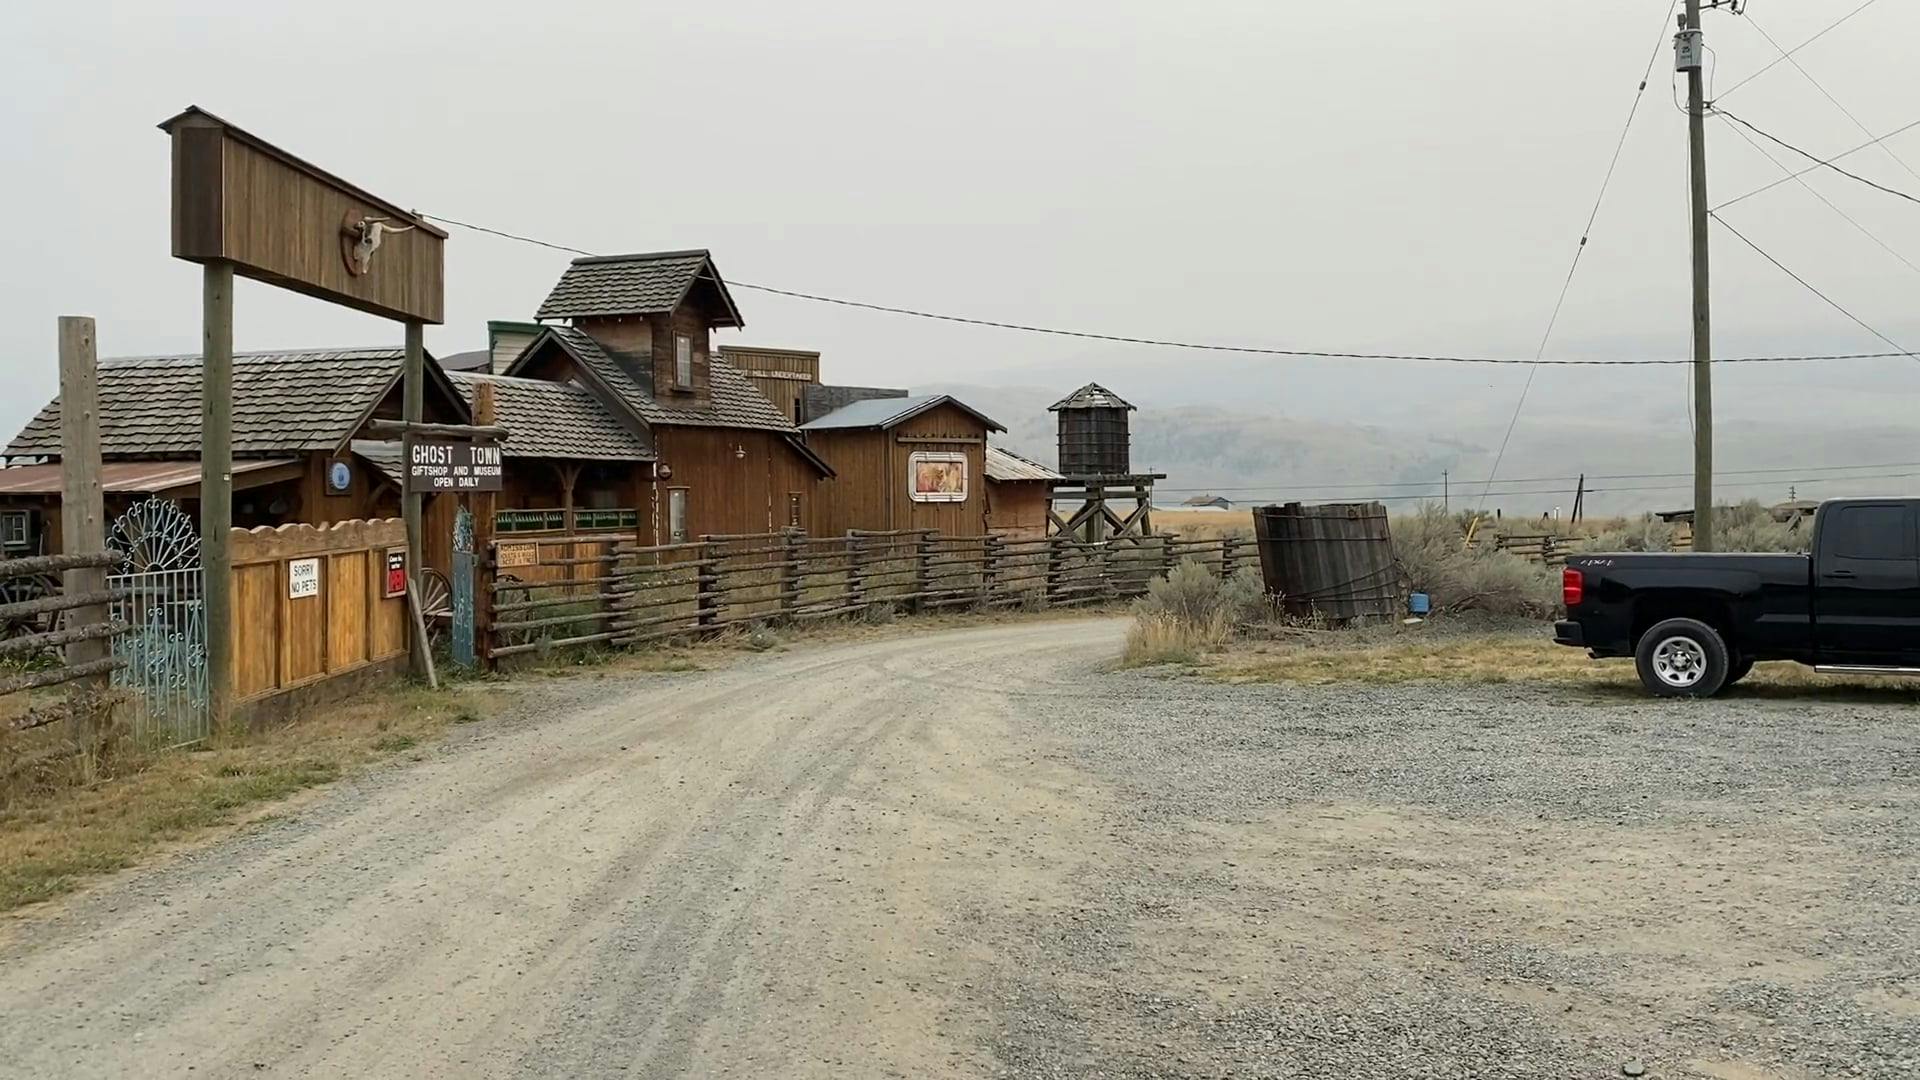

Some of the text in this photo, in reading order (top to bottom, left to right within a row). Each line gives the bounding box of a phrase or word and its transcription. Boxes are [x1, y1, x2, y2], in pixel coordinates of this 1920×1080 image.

[412, 445, 500, 465] GHOST TOWN
[411, 466, 501, 476] GIFTSHOP AND MUSEUM
[434, 477, 480, 487] OPEN DAILY
[293, 564, 314, 577] SORRY
[291, 579, 317, 593] NO PETS
